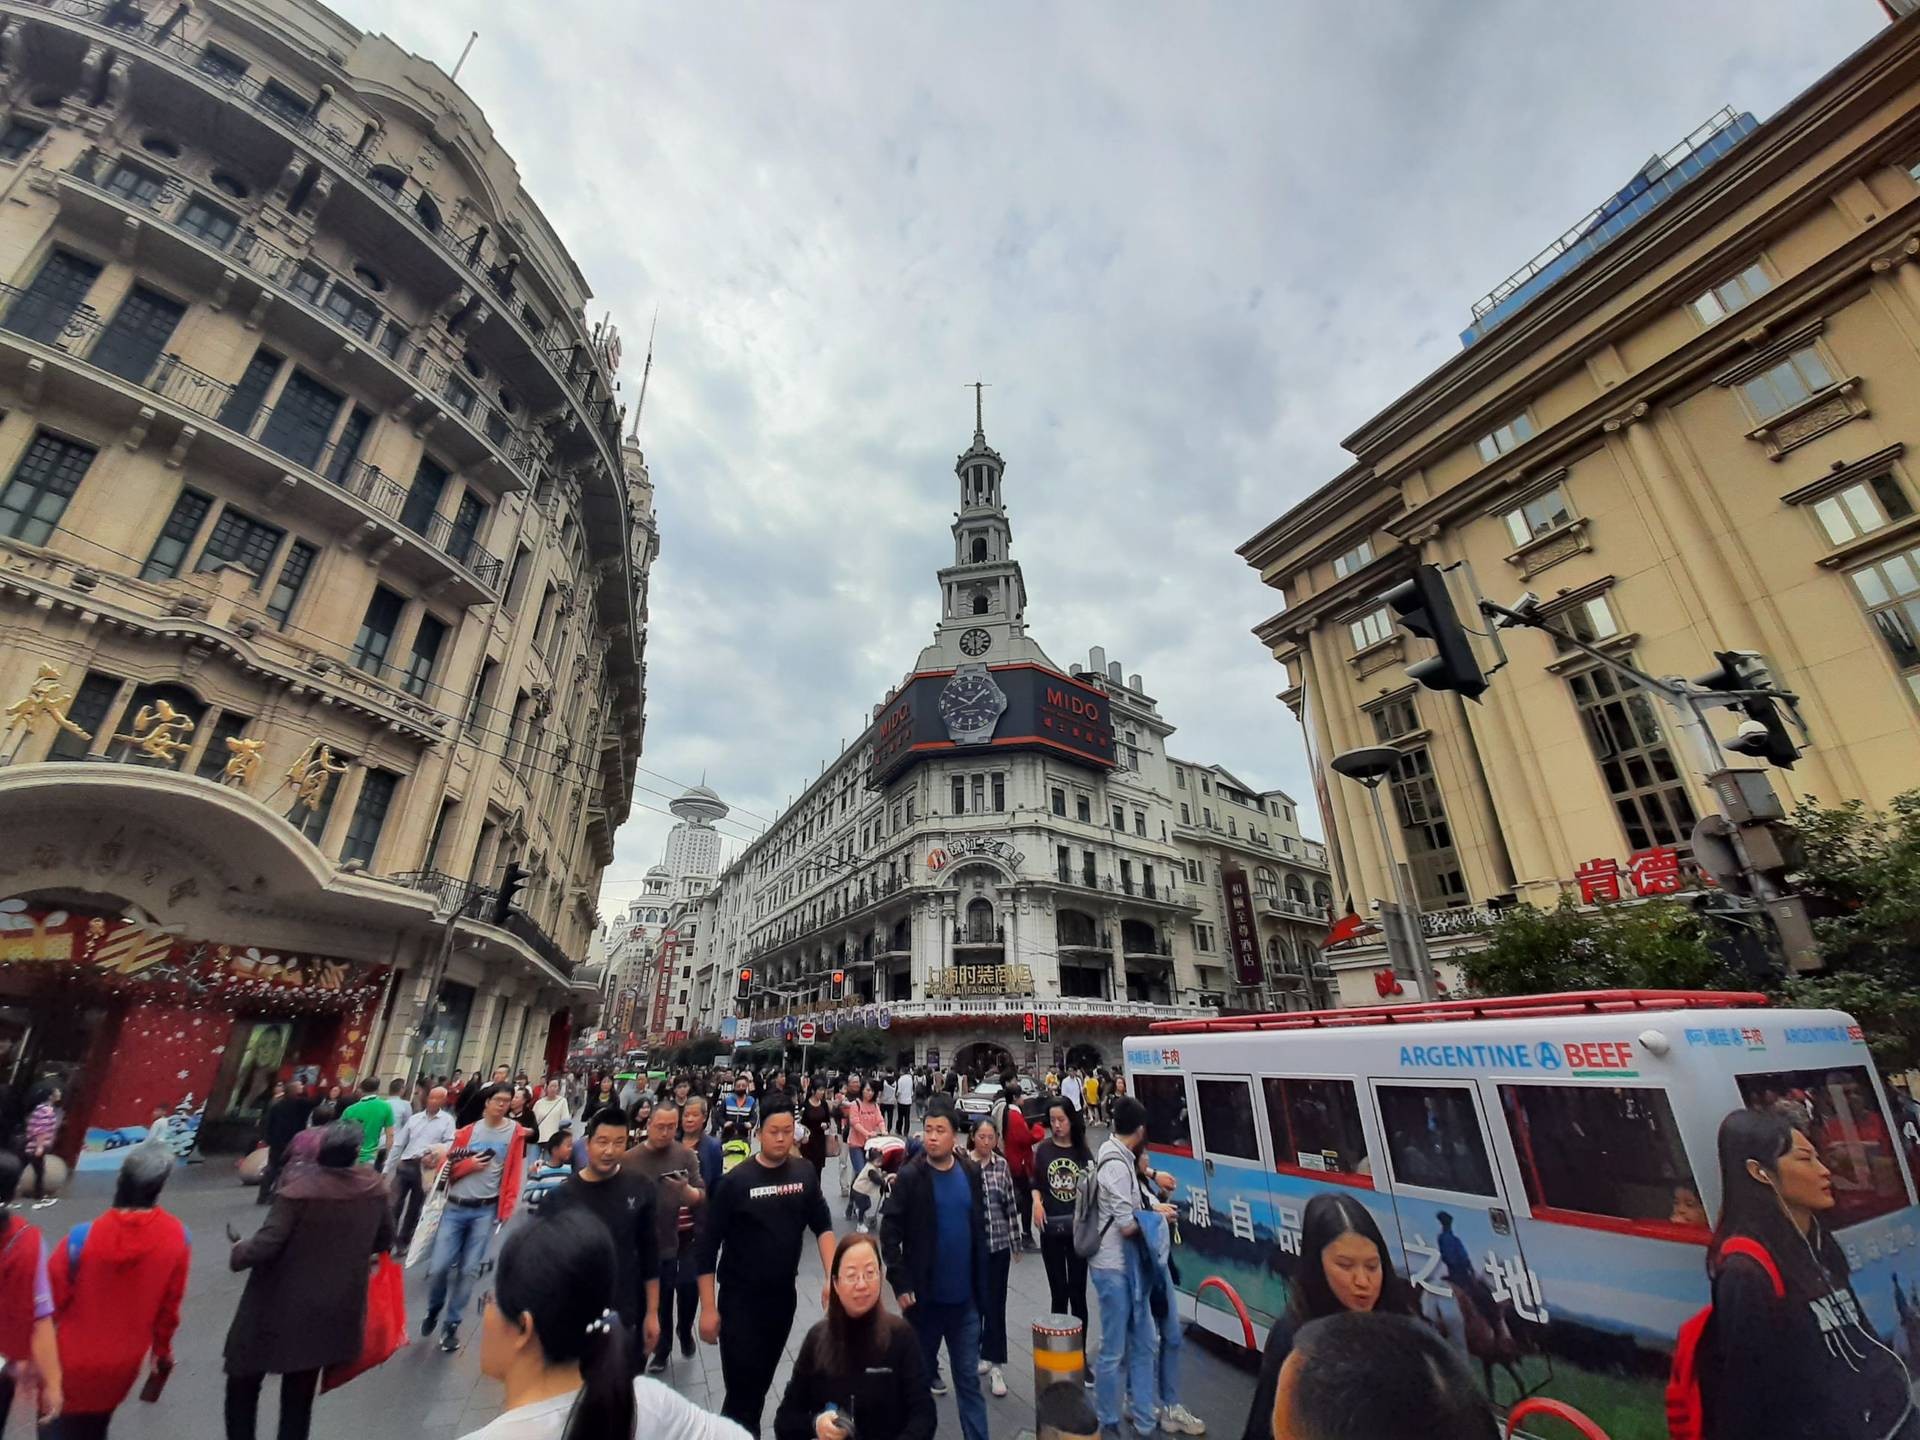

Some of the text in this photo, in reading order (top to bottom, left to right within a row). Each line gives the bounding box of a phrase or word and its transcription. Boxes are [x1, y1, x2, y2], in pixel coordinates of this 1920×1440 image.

[1047, 686, 1099, 721] MIDO
[880, 701, 908, 737] MIDO
[968, 985, 1003, 995] FASHION
[1741, 1027, 1765, 1046] 牛肉
[1162, 1048, 1180, 1065] 牛肉
[1400, 1045, 1532, 1068] ARGENTINE
[1563, 1043, 1634, 1068] BEEF
